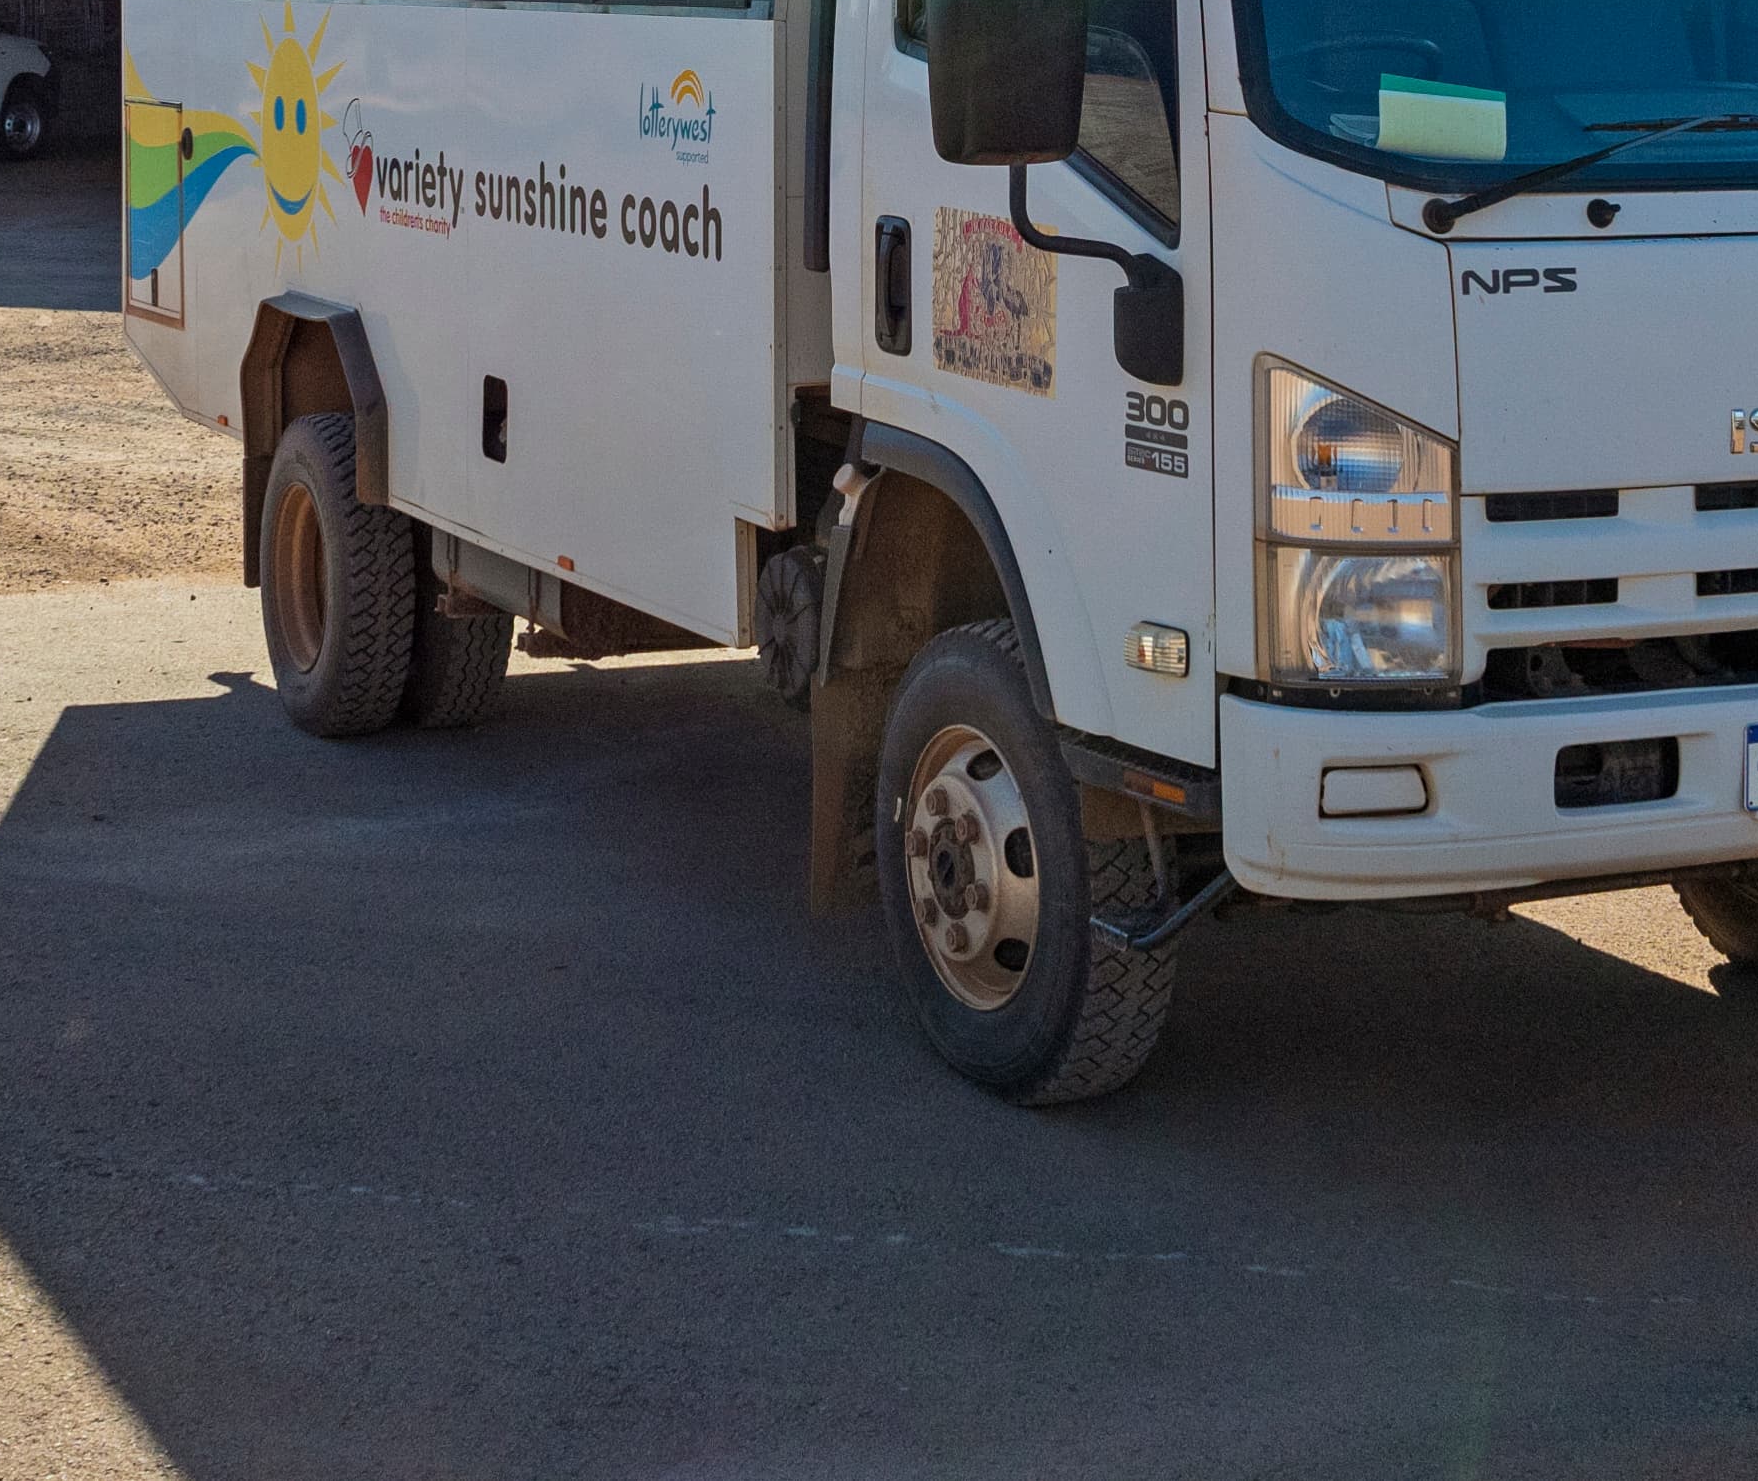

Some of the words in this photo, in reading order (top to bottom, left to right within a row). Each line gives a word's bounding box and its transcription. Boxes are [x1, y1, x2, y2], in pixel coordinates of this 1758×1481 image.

[639, 82, 716, 151] lotterywest
[676, 150, 709, 167] supported
[376, 148, 464, 229] variety
[475, 160, 608, 239] sunshine
[621, 183, 722, 262] coach
[379, 205, 391, 224] the
[425, 214, 451, 240] charity
[1461, 267, 1577, 295] NPS
[1126, 390, 1190, 431] 300
[1151, 451, 1186, 474] 155
